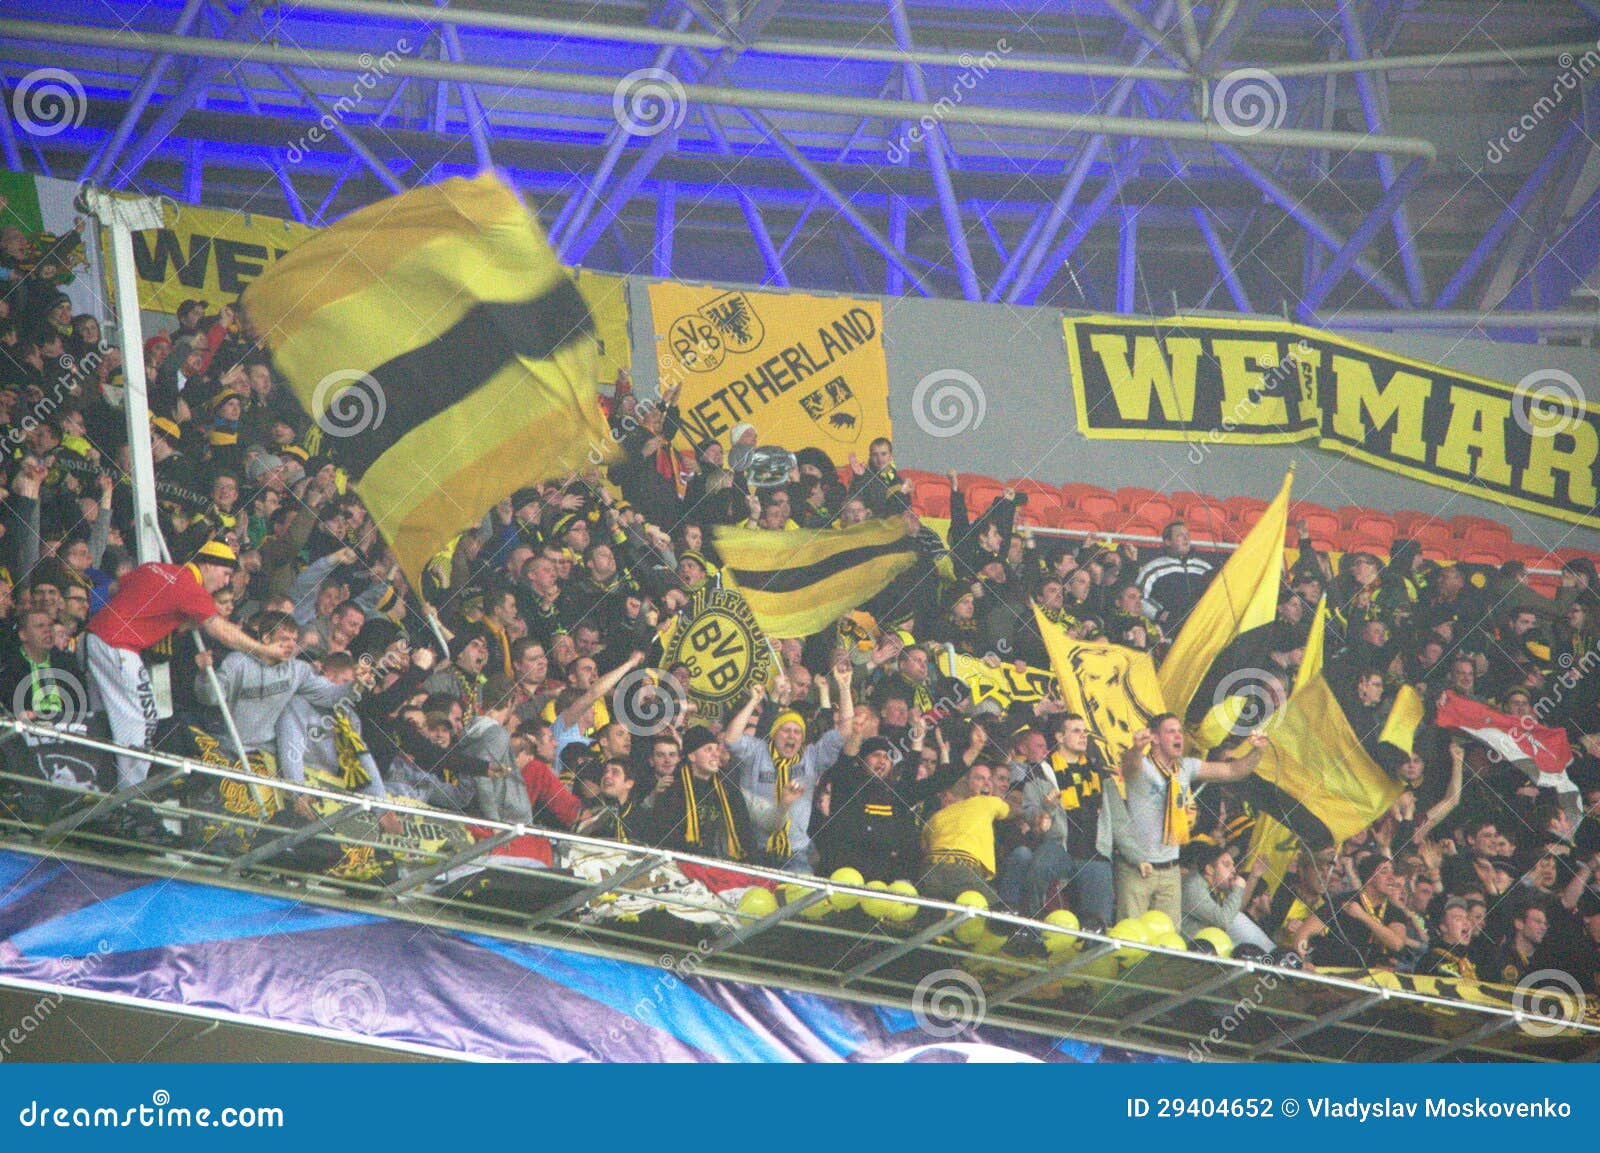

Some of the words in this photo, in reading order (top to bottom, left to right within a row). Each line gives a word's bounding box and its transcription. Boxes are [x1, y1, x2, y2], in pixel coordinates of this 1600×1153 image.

[674, 319, 720, 366] BVB
[680, 307, 875, 450] NETPHERLAND
[1090, 333, 1600, 507] WEIMAR
[684, 655, 703, 678] 09
[690, 619, 745, 691] BVB
